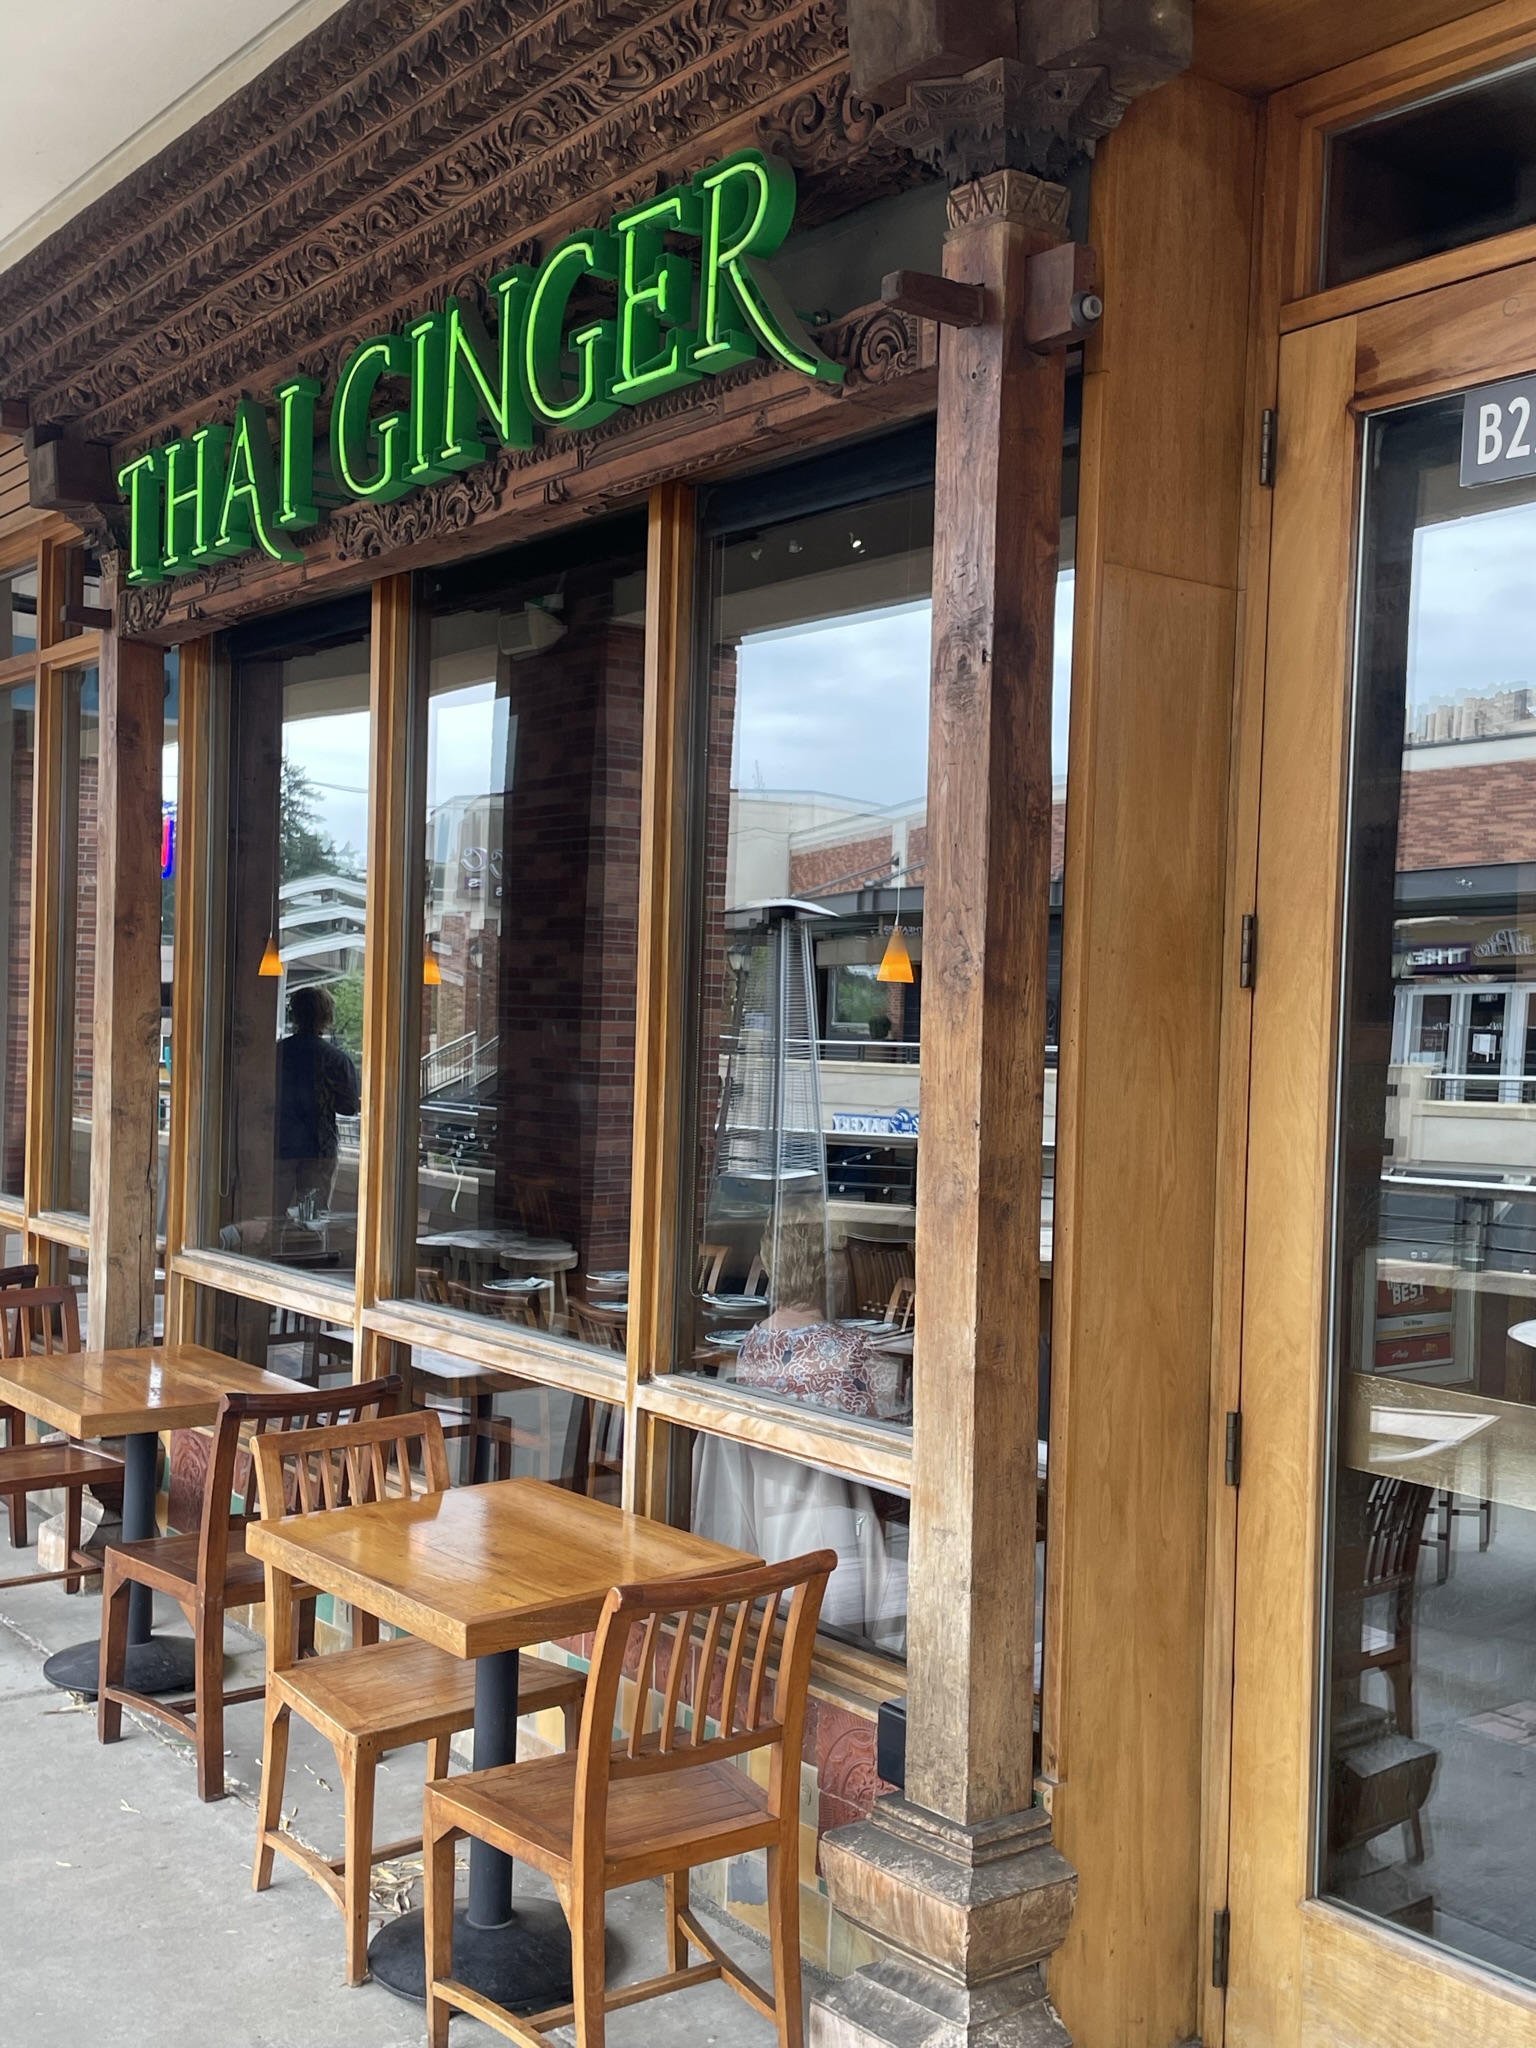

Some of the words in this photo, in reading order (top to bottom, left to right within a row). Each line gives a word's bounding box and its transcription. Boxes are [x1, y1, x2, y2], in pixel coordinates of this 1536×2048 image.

[117, 377, 322, 587] THAI
[331, 146, 844, 503] GINGER
[1477, 396, 1536, 465] B2
[1392, 1278, 1426, 1305] BEST
